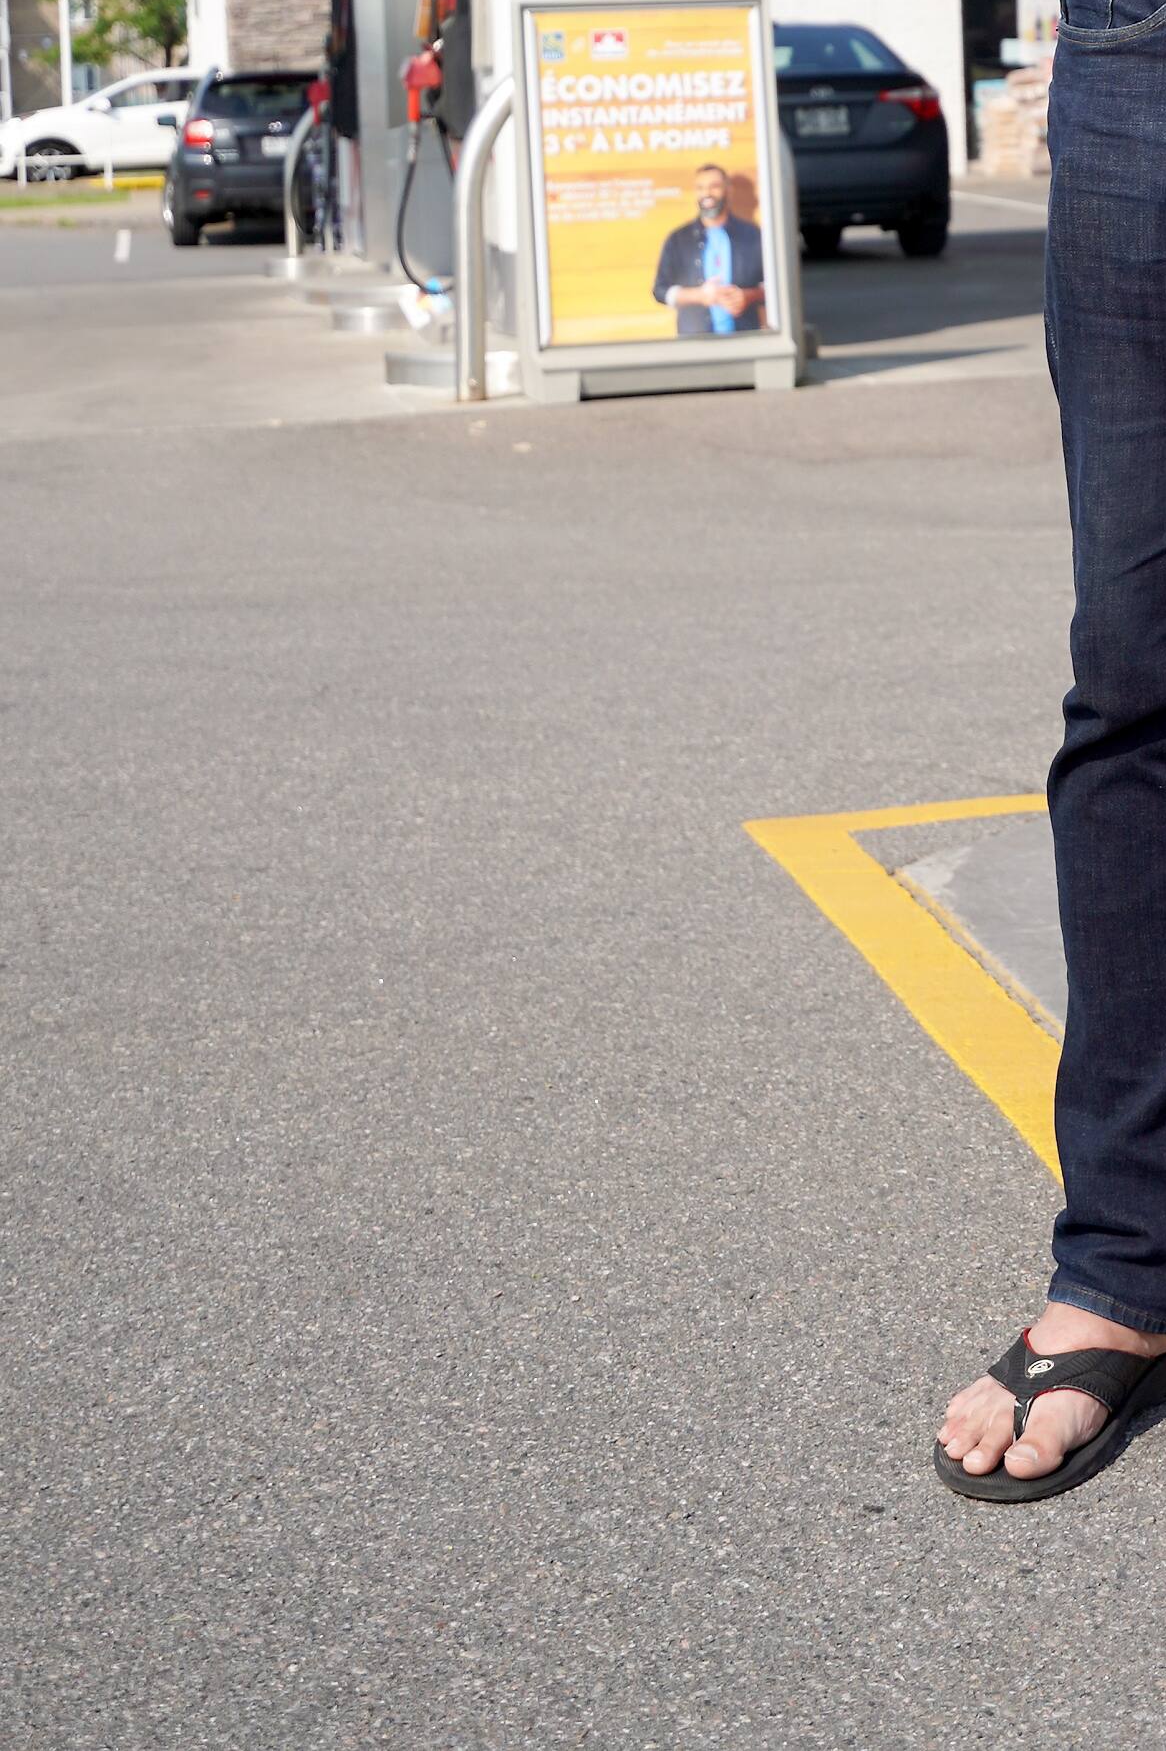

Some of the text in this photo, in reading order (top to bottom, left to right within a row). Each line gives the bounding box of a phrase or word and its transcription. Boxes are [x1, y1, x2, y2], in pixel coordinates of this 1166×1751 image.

[541, 69, 747, 103] ÉCONOMISEZ
[591, 126, 610, 152] À
[614, 130, 644, 152] LA
[649, 127, 732, 151] POMPE
